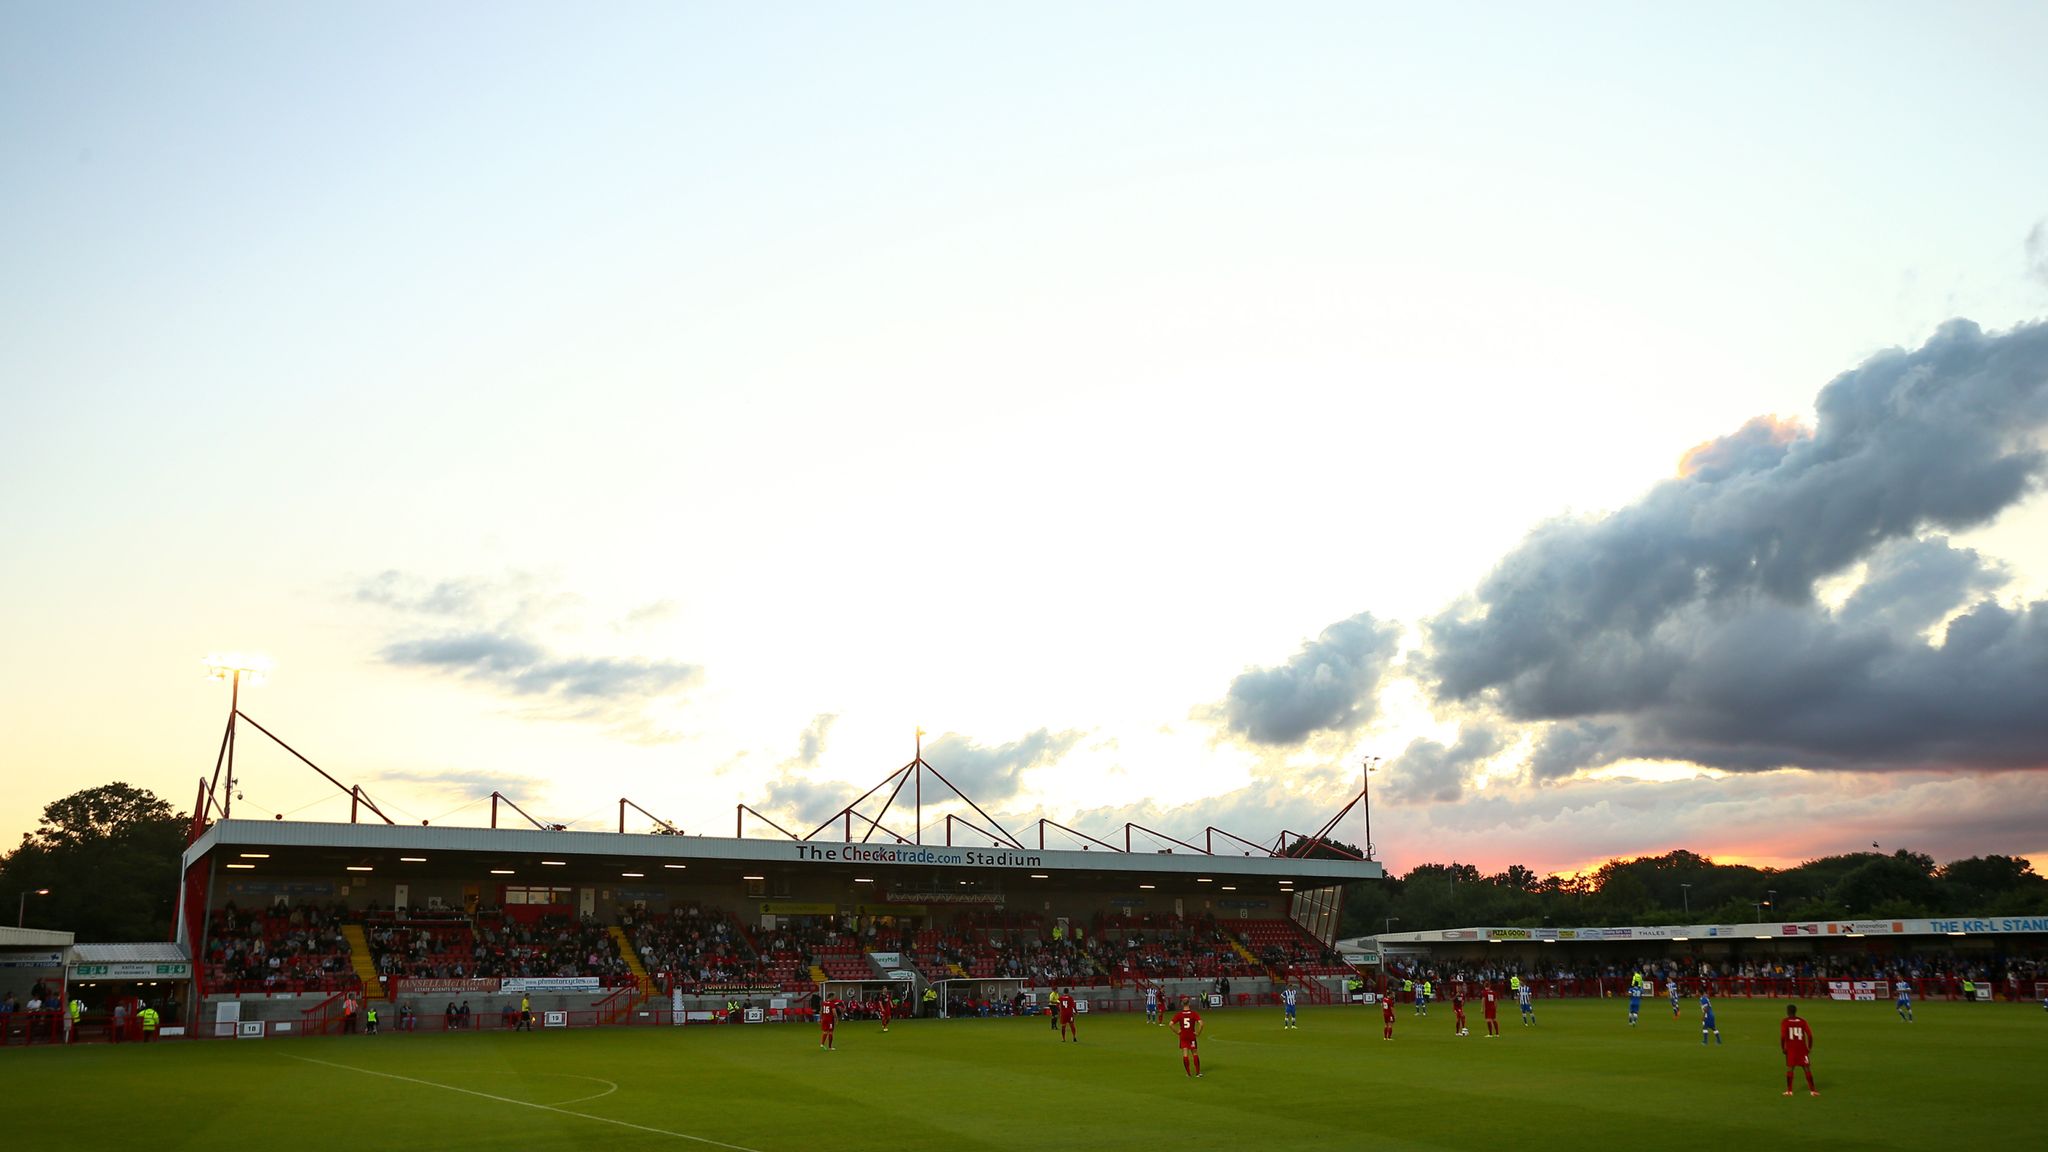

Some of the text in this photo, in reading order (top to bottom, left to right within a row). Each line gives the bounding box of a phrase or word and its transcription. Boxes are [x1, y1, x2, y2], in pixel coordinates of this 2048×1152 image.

[796, 846, 1042, 867] The Checkatrade.com Stadium
[1930, 919, 2048, 932] THE KR-L STAND
[1492, 929, 1508, 937] PIZZA
[1183, 1017, 1191, 1029] 5
[1788, 1026, 1804, 1041] 14
